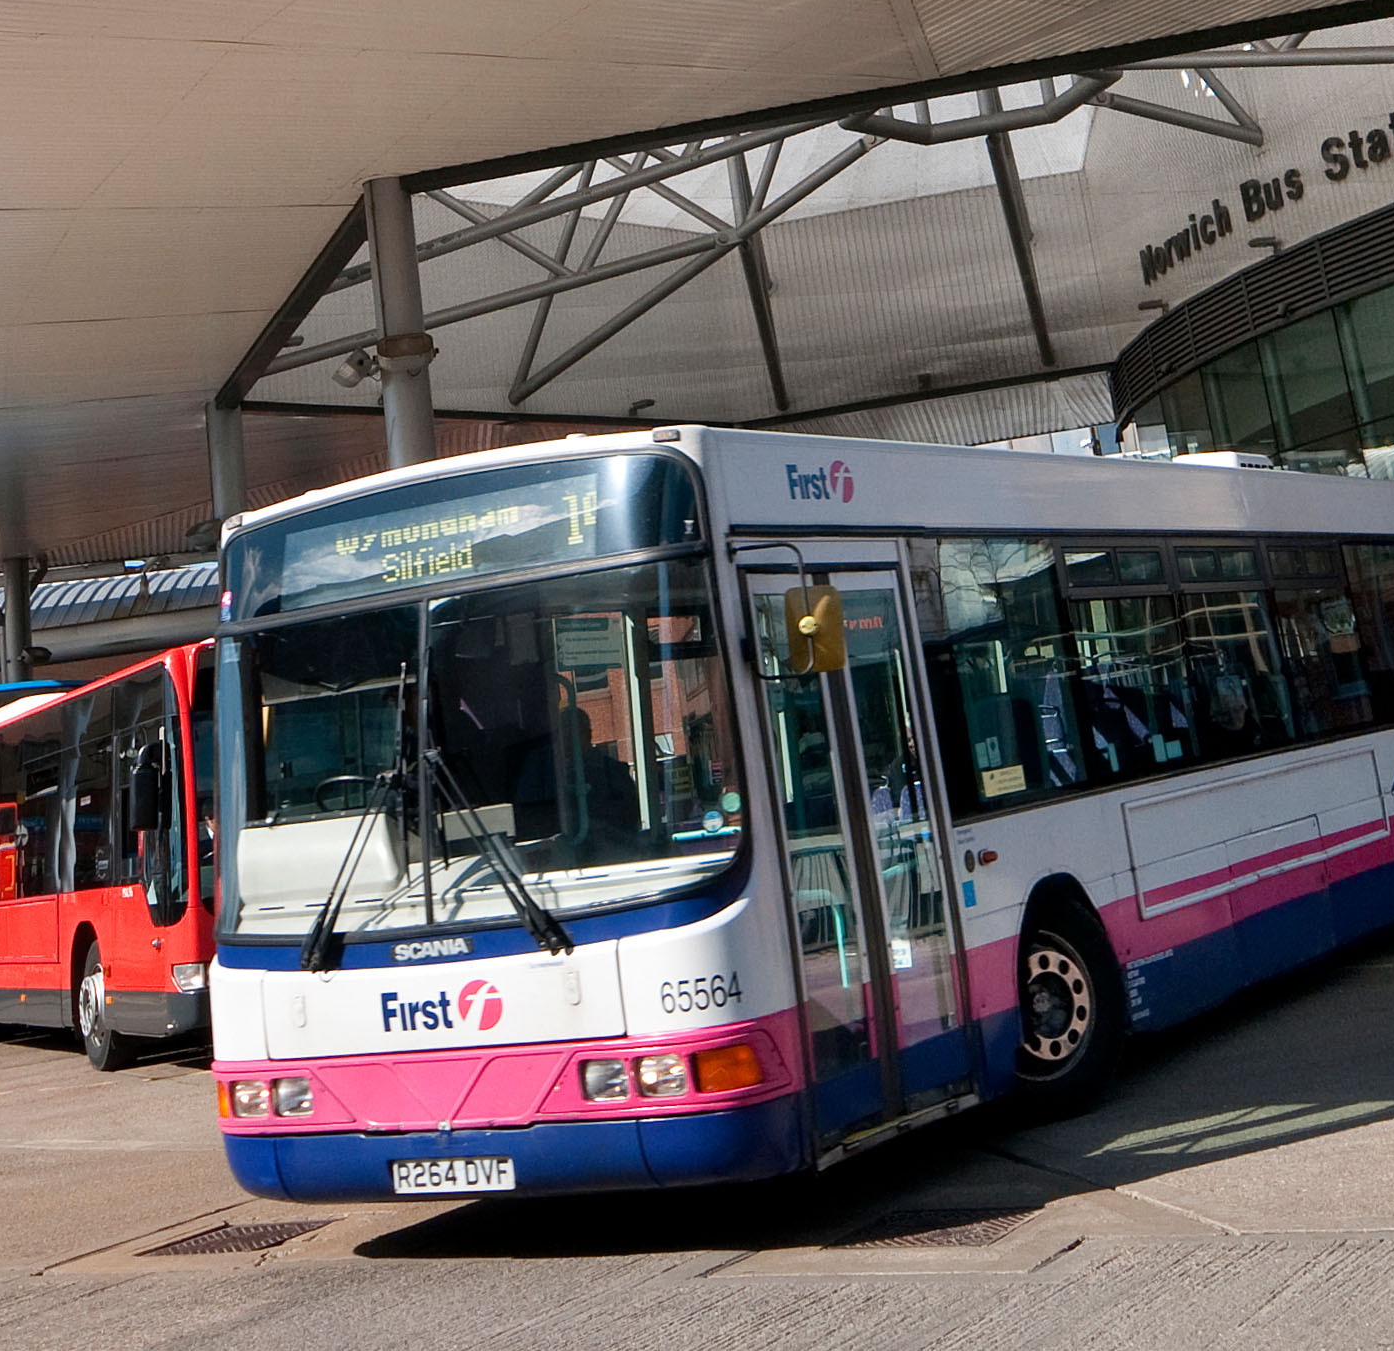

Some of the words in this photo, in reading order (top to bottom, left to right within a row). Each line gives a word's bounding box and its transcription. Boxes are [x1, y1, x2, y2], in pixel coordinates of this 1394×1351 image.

[1139, 199, 1233, 287] Norwich
[1239, 168, 1304, 223] Bus
[785, 463, 831, 500] First
[381, 539, 474, 583] Silfield
[394, 937, 470, 961] SCANIA
[381, 991, 454, 1032] First
[660, 970, 743, 1014] 65564
[397, 1160, 457, 1189] R264
[465, 1158, 509, 1186] DVF
